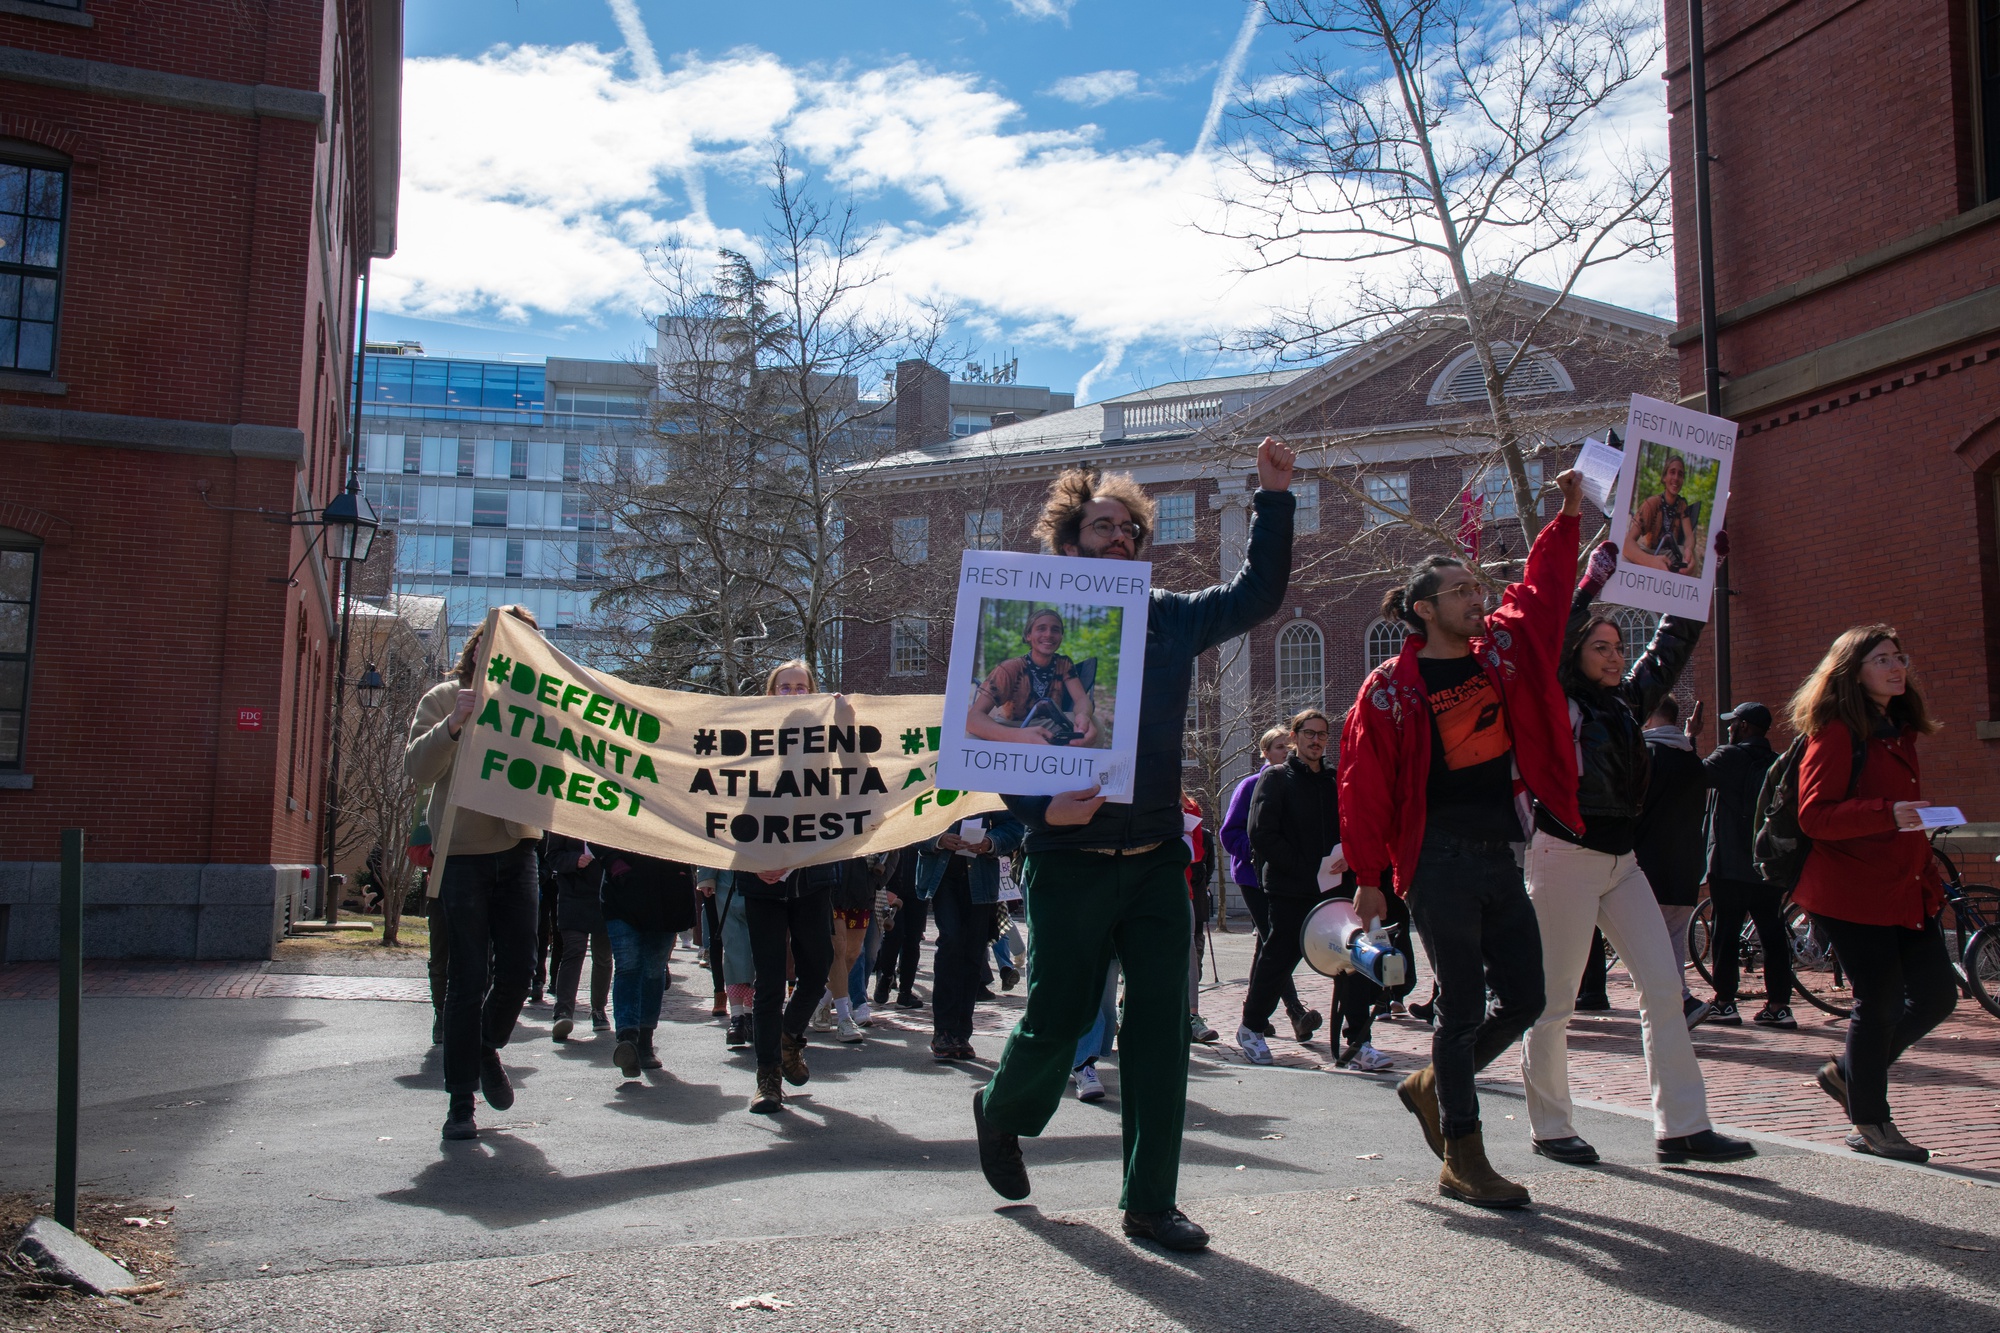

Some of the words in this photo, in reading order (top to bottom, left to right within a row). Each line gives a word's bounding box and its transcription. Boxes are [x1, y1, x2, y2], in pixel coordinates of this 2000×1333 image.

[1632, 410, 1668, 433] REST
[1668, 420, 1684, 438] IN
[1686, 425, 1734, 452] POWER
[966, 567, 1023, 587] REST
[1029, 571, 1052, 590] IN
[1059, 573, 1145, 596] POWER
[1617, 570, 1700, 602] TORTUGUITA
[487, 653, 662, 744] #DEFEND
[240, 711, 261, 720] FDC
[477, 698, 660, 784] ATLANTA
[693, 725, 882, 757] #DEFEND
[961, 748, 1095, 778] TORTUGUIT
[480, 749, 645, 817] FOREST
[688, 766, 889, 799] ATLANTA
[705, 809, 872, 845] FOREST
